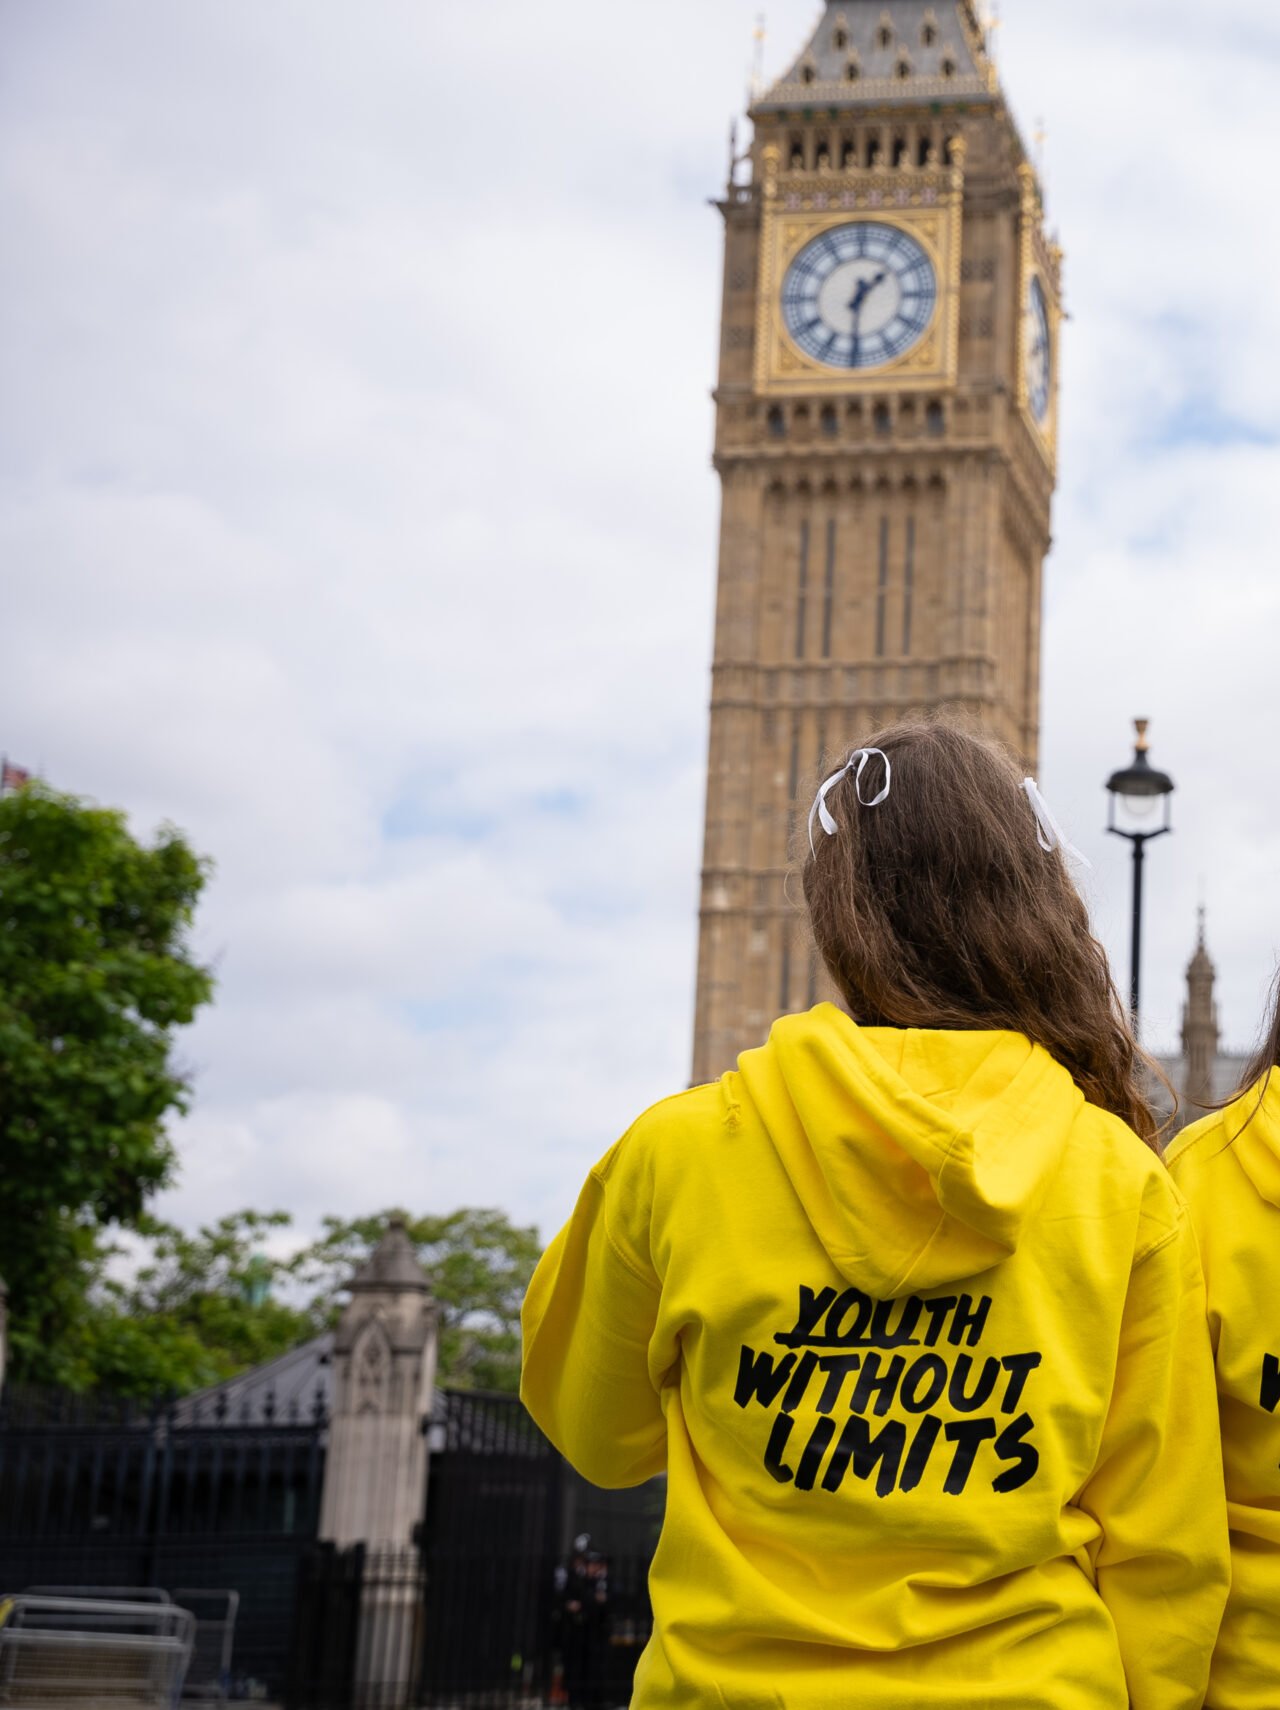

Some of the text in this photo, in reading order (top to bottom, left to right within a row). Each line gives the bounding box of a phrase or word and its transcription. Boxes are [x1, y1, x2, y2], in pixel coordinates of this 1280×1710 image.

[773, 1284, 993, 1349] YOUTH
[733, 1344, 1042, 1417] WITHOUT
[764, 1412, 1040, 1498] LIMITS
